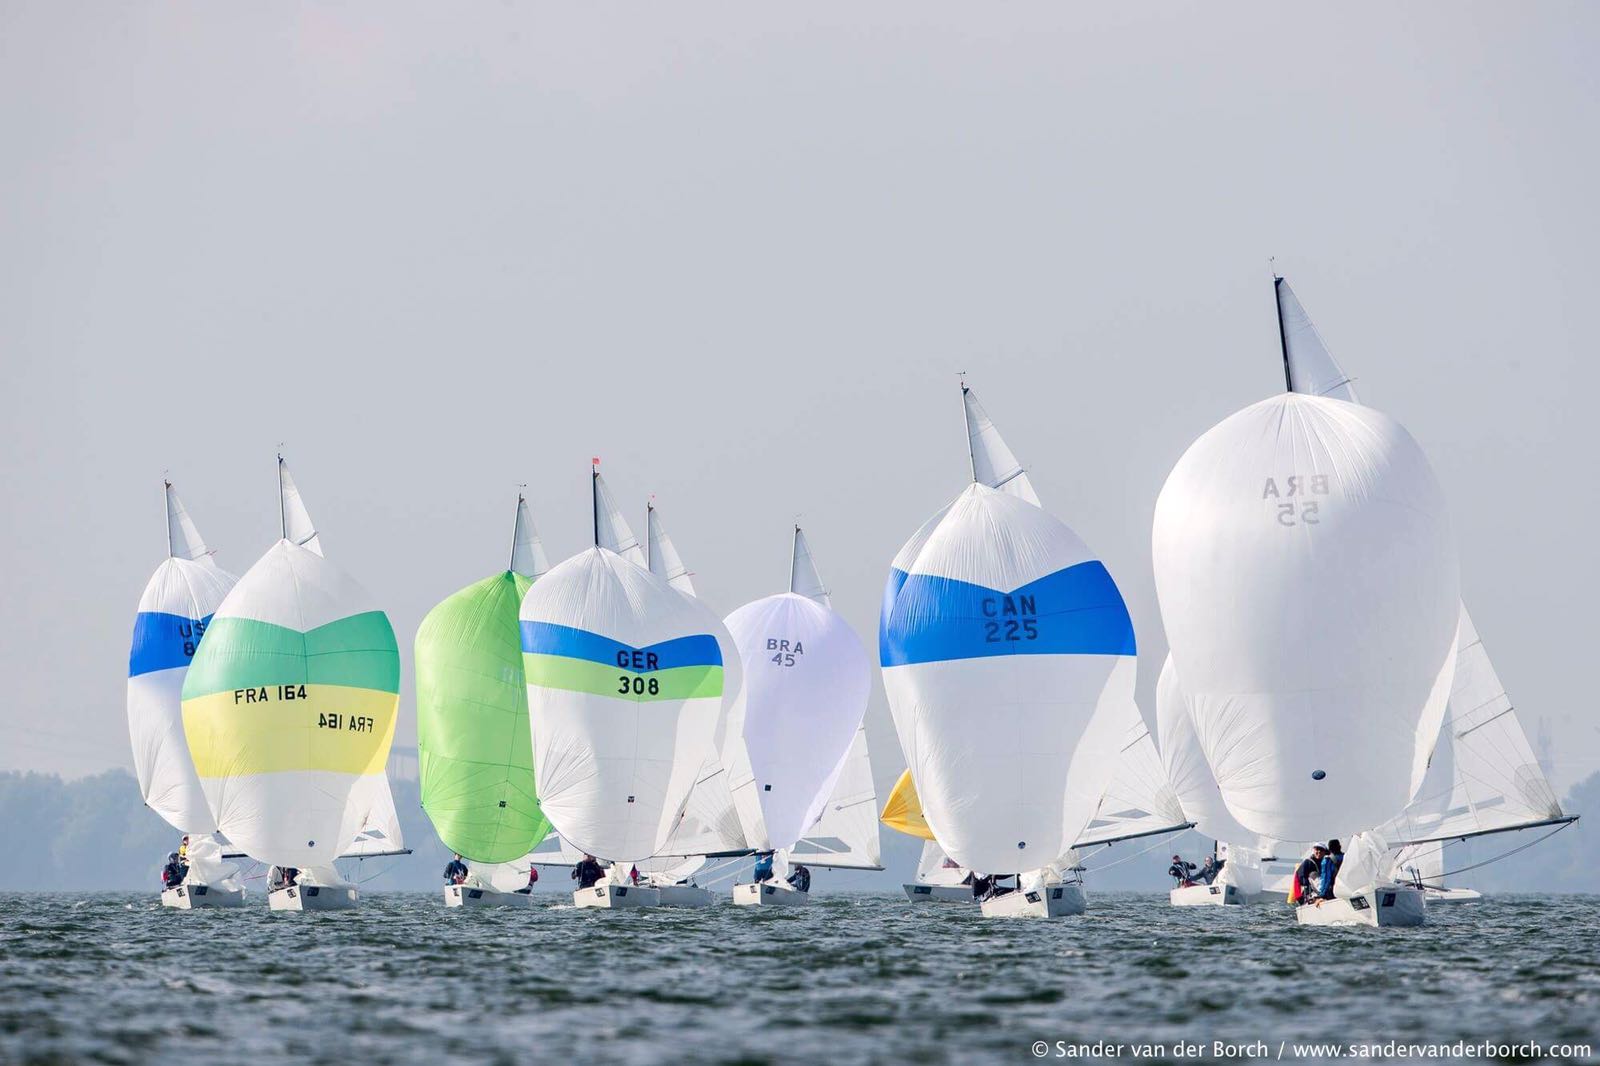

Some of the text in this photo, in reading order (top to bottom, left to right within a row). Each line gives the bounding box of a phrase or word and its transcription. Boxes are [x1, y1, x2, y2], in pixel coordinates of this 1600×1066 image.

[982, 594, 1037, 618] CAN
[179, 621, 207, 638] US
[984, 619, 1038, 644] 225
[766, 638, 804, 655] BRA
[617, 650, 659, 671] GER
[771, 652, 796, 667] 45
[234, 684, 307, 705] FRA 164
[617, 676, 660, 696] 308
